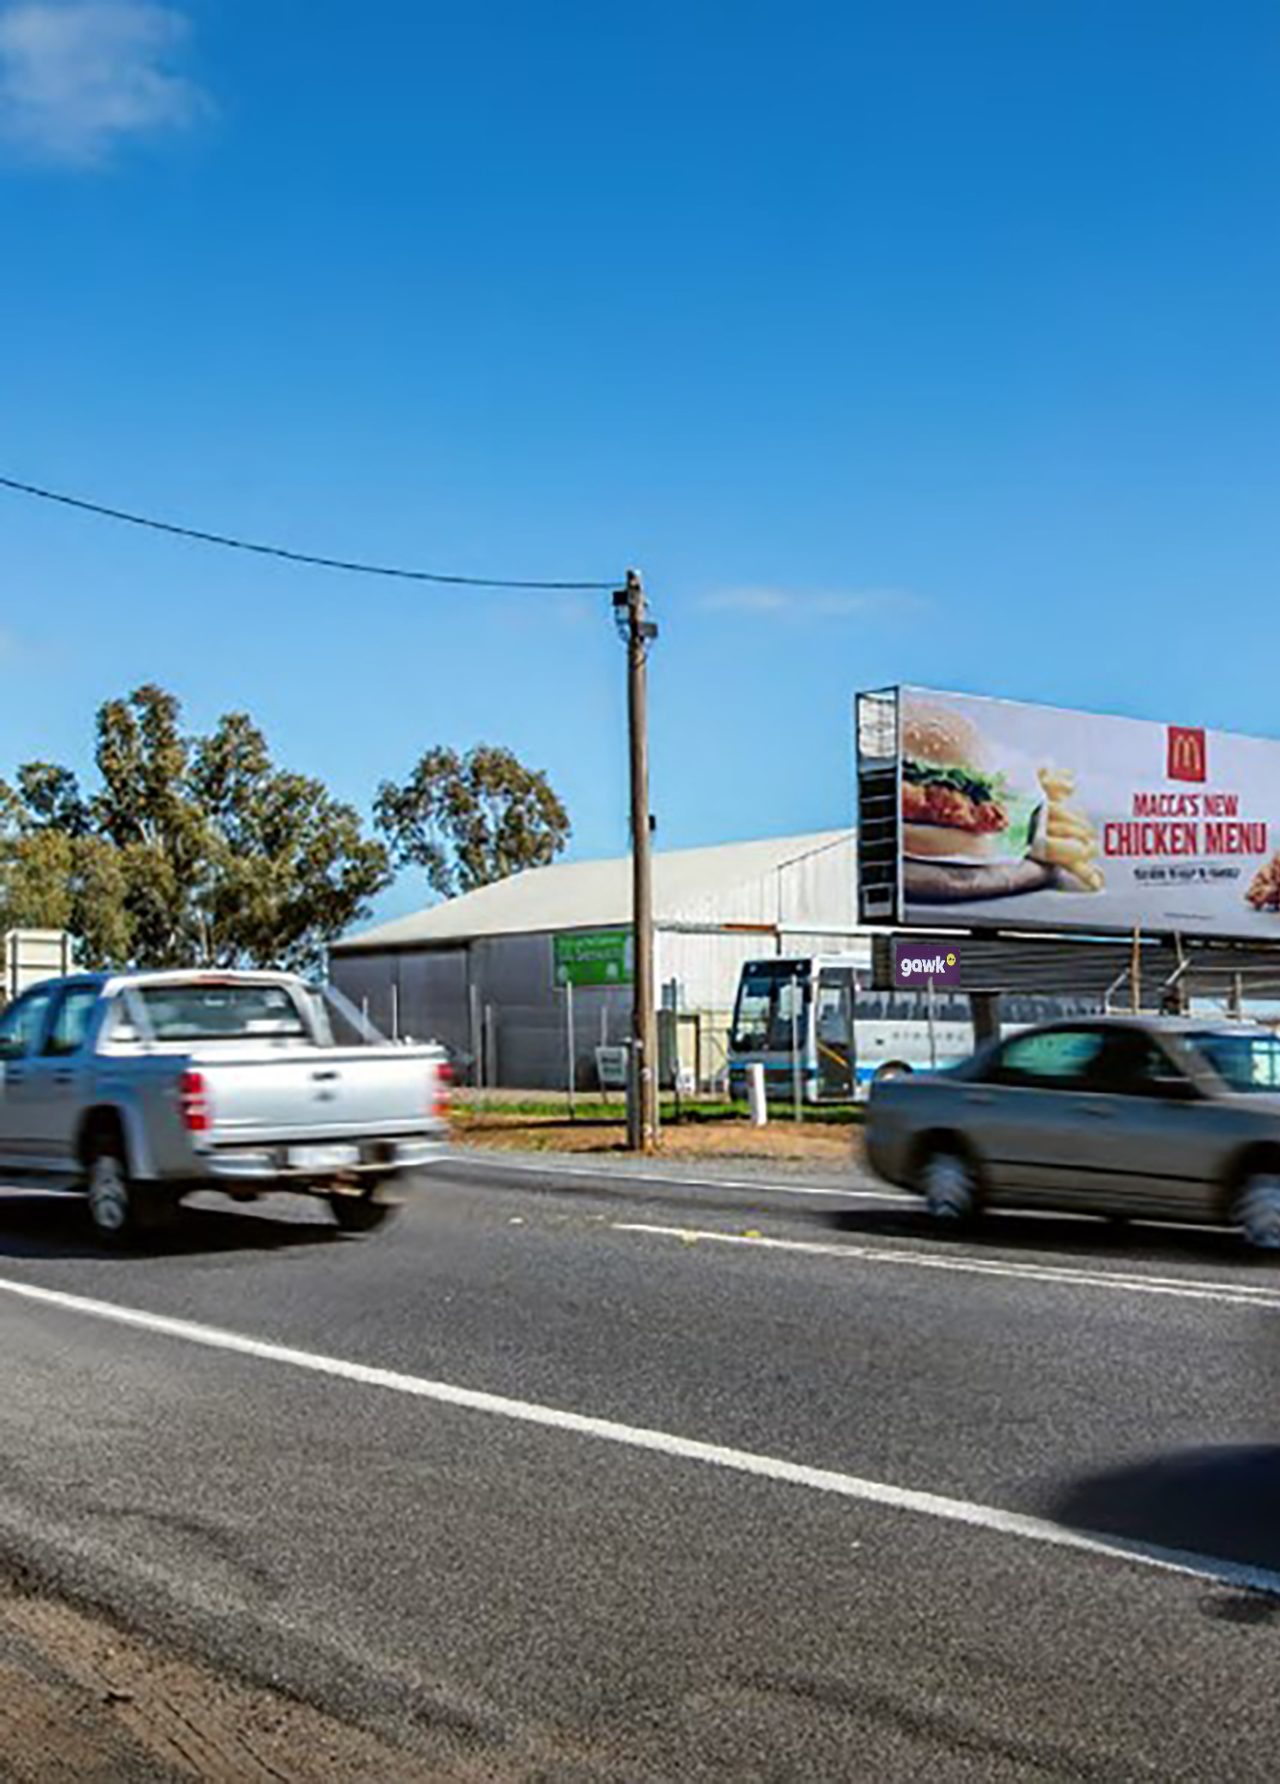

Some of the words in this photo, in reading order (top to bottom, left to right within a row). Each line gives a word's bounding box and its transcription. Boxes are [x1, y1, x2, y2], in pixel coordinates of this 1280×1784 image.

[1133, 793, 1200, 817] MACCA'S
[1204, 794, 1239, 817] NEW
[1104, 822, 1198, 856] CHICKEN
[1205, 822, 1267, 854] MENU
[901, 955, 946, 978] gawk
